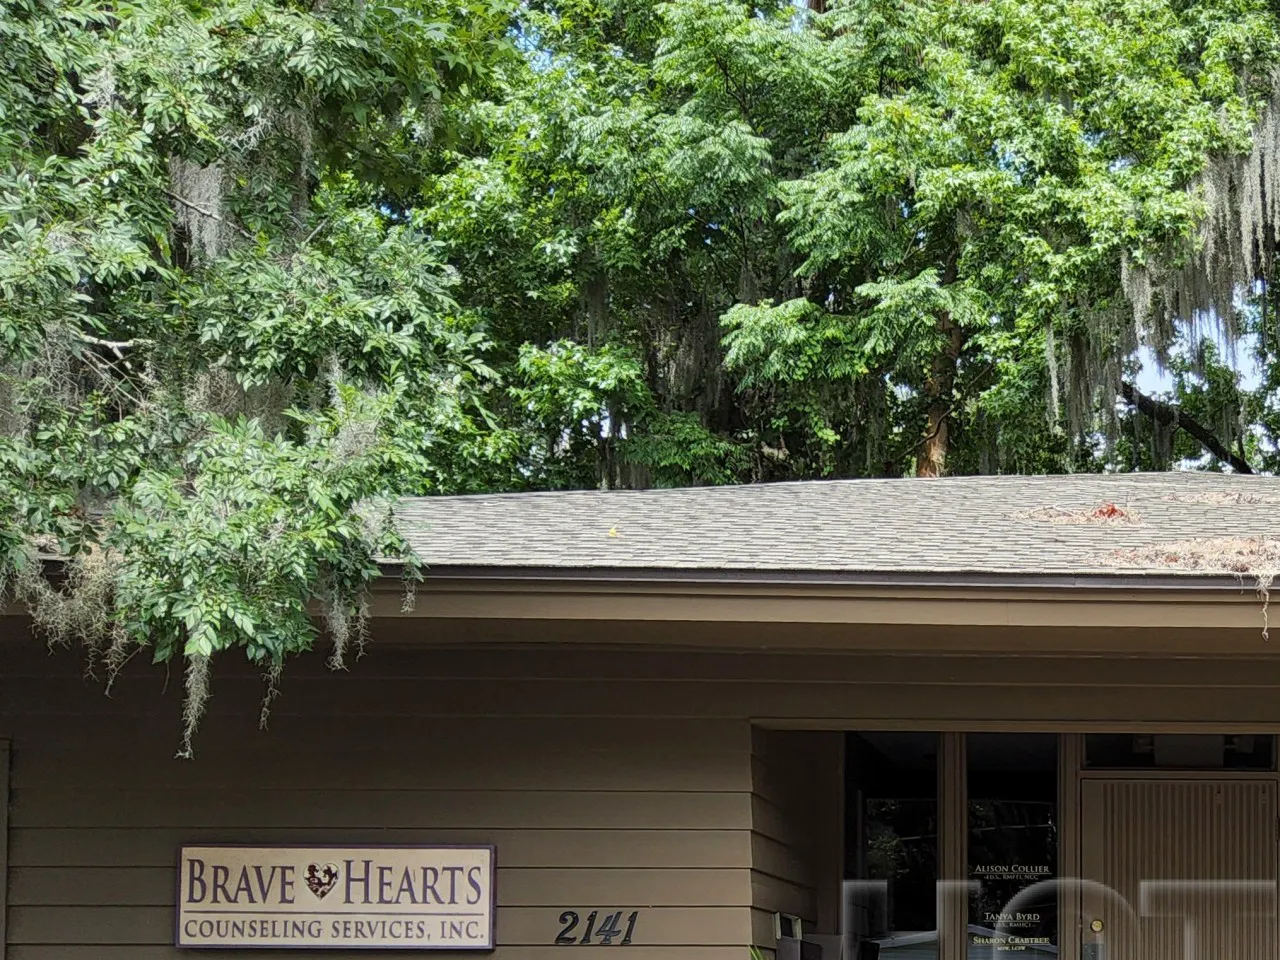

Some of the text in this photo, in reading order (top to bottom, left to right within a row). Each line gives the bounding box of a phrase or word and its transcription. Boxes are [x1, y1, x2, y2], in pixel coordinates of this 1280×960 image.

[975, 864, 1050, 873] ALISON COLLIER
[186, 858, 482, 905] BRAVE HEARTS
[984, 912, 1041, 920] TANYA BYRD
[184, 919, 484, 941] COUNSELING SERVICES, INC.
[554, 911, 639, 944] 2141
